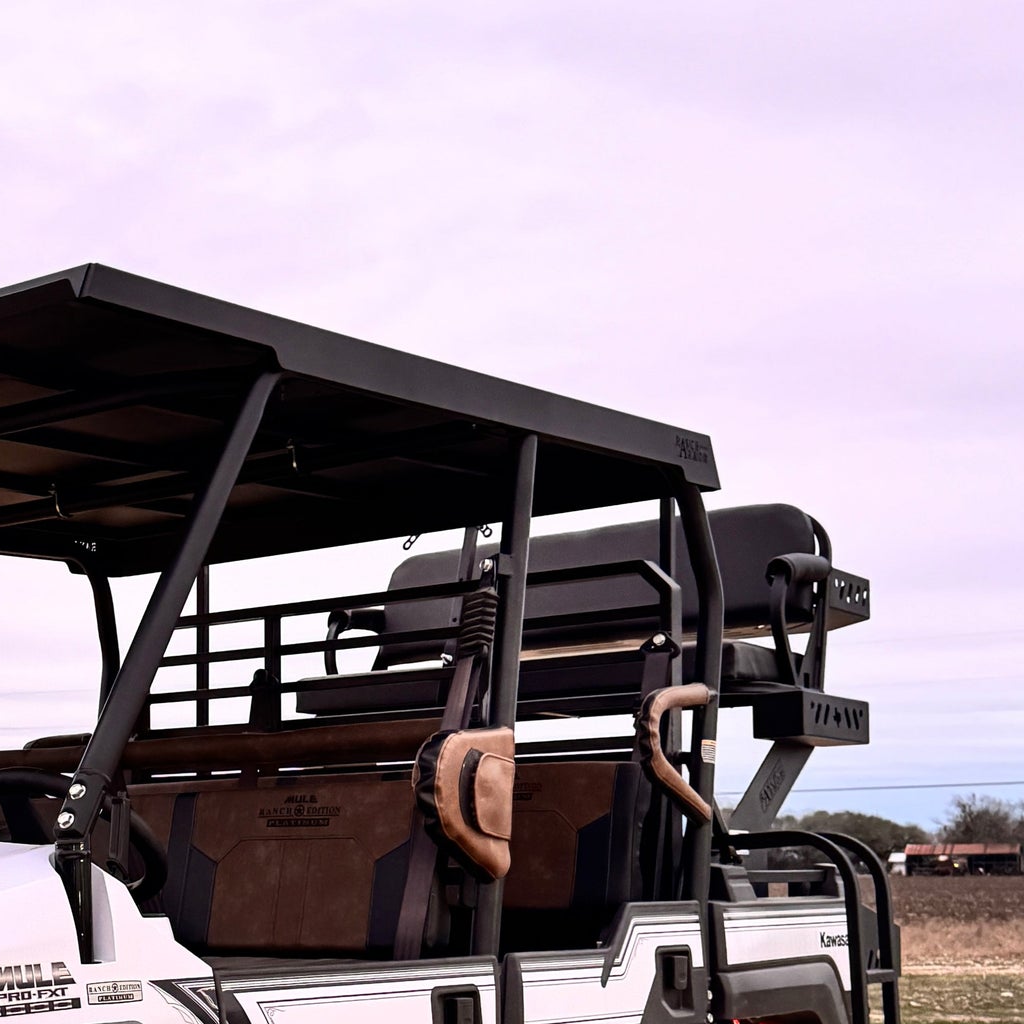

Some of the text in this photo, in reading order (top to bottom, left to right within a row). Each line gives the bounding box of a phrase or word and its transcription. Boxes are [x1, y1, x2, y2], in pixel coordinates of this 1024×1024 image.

[284, 795, 318, 803] MULE
[259, 806, 341, 815] RANCH EDITION
[820, 932, 849, 948] Kawasa
[88, 983, 141, 993] RANCH EDITION
[98, 993, 134, 1002] PLATINUM
